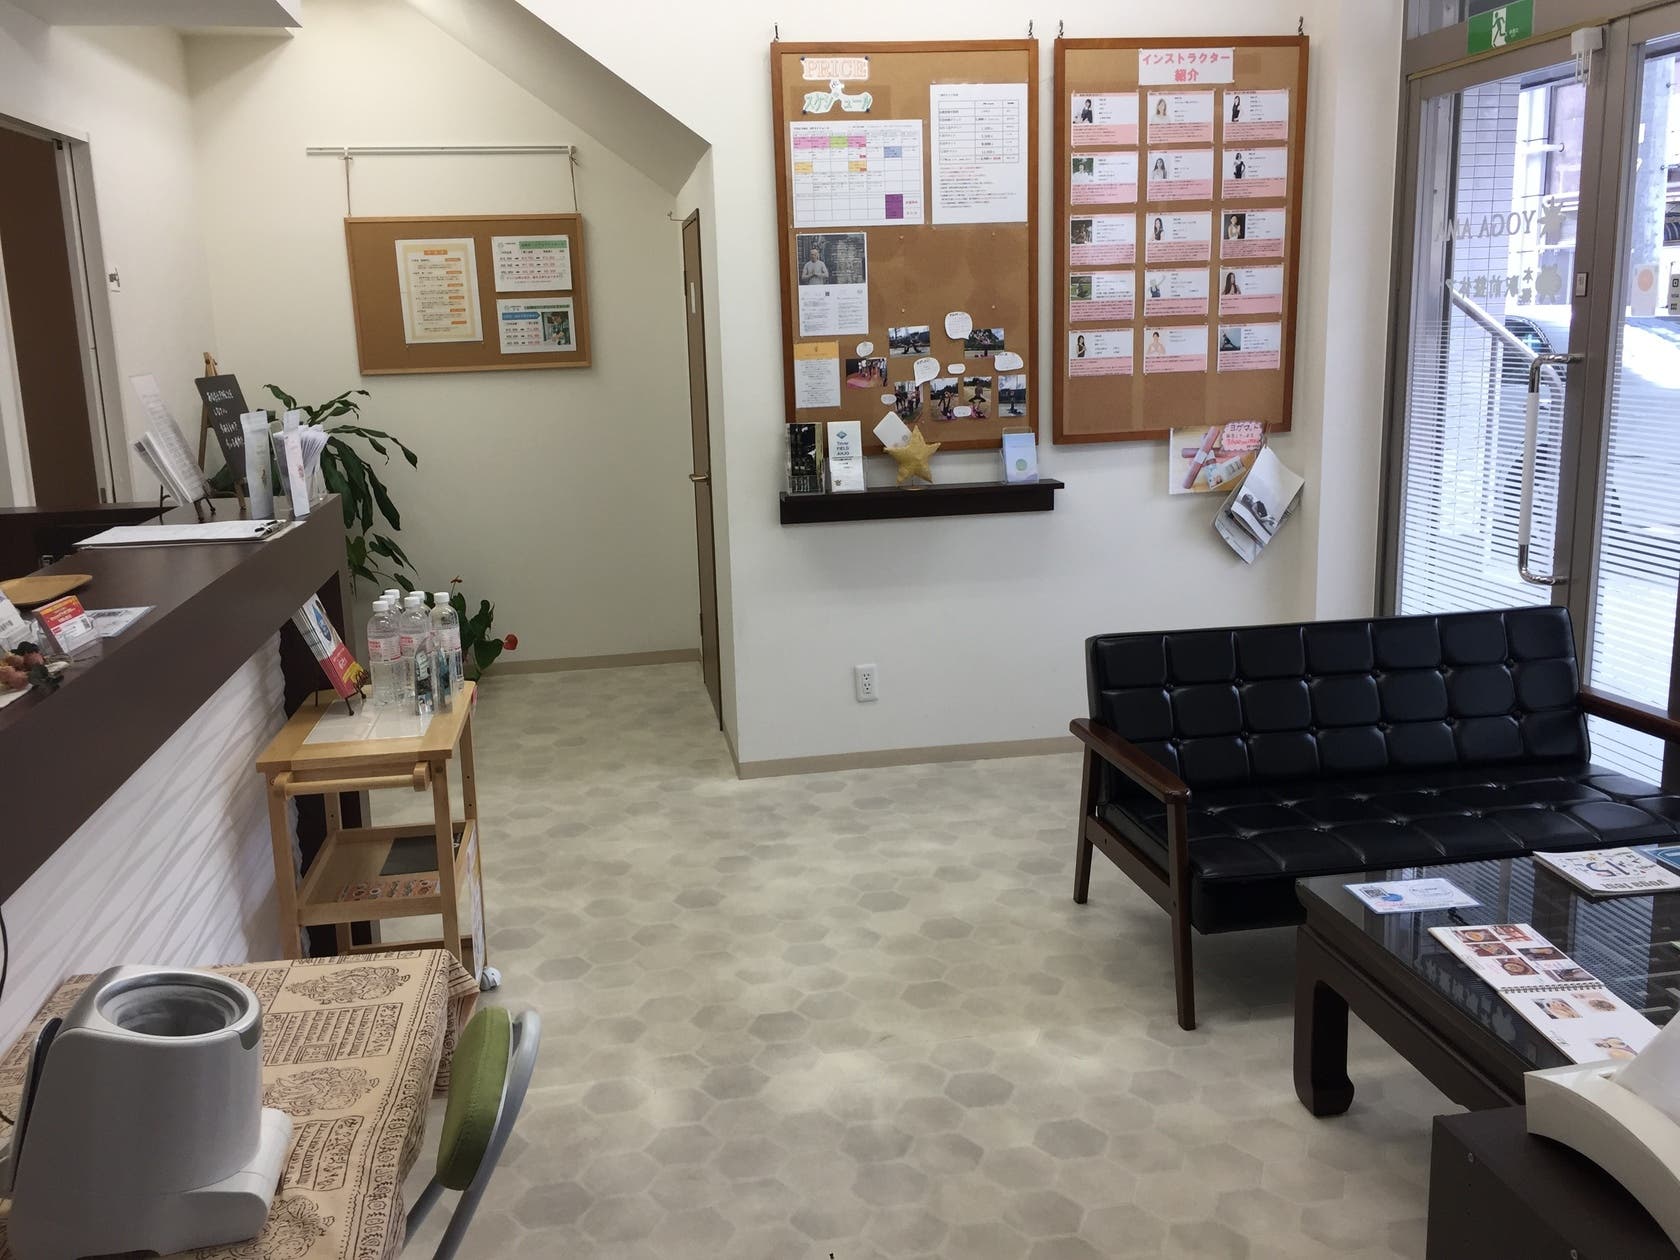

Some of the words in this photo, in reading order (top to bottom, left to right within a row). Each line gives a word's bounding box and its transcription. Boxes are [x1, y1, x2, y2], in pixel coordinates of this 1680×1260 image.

[1142, 52, 1231, 66] インストラクター
[804, 60, 867, 77] PRICE
[1174, 67, 1200, 82] 紹介
